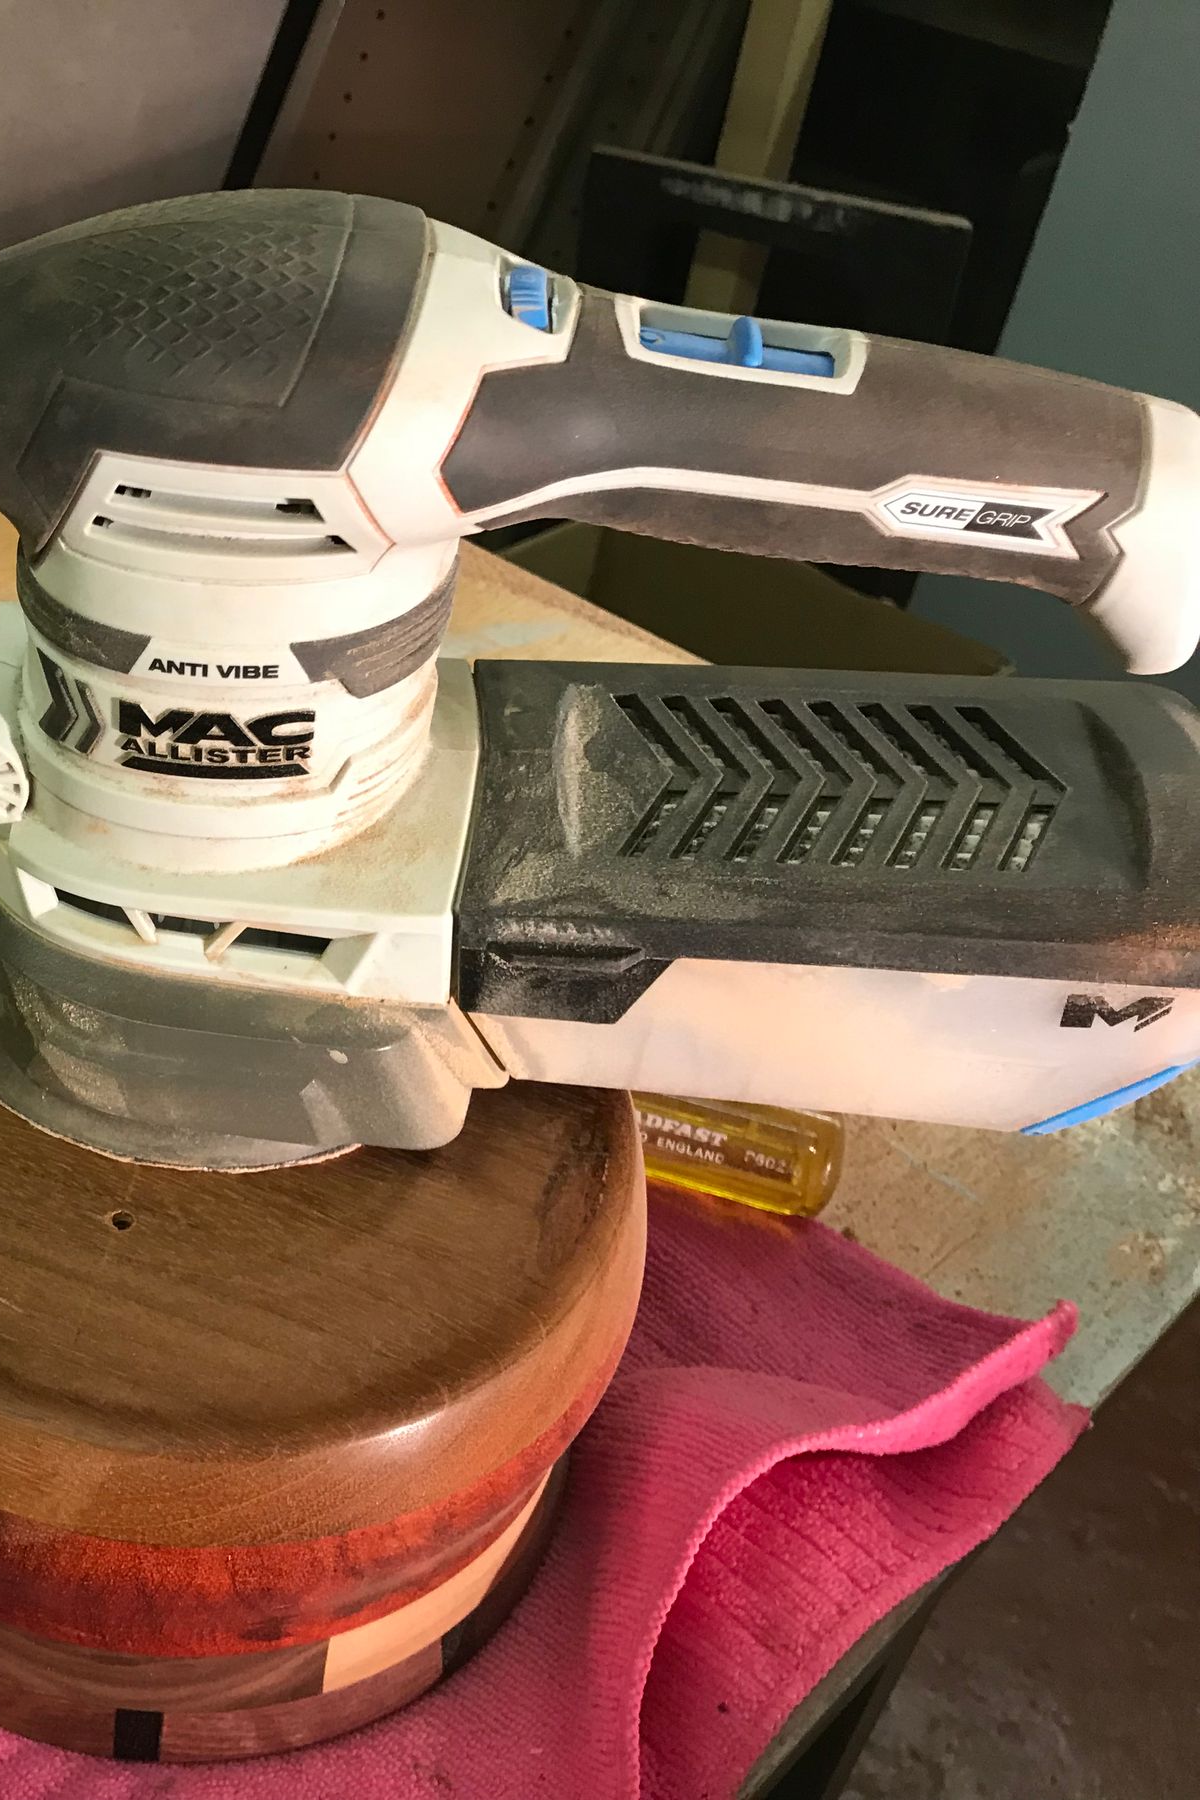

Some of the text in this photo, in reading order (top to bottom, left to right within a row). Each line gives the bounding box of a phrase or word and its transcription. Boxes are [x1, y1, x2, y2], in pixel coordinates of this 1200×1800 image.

[900, 502, 1032, 528] SURE GRIP
[148, 658, 279, 680] ANTI VIBE
[117, 699, 316, 747] MAC
[120, 737, 311, 764] ALLISTER
[656, 1137, 726, 1166] ENGLAND
